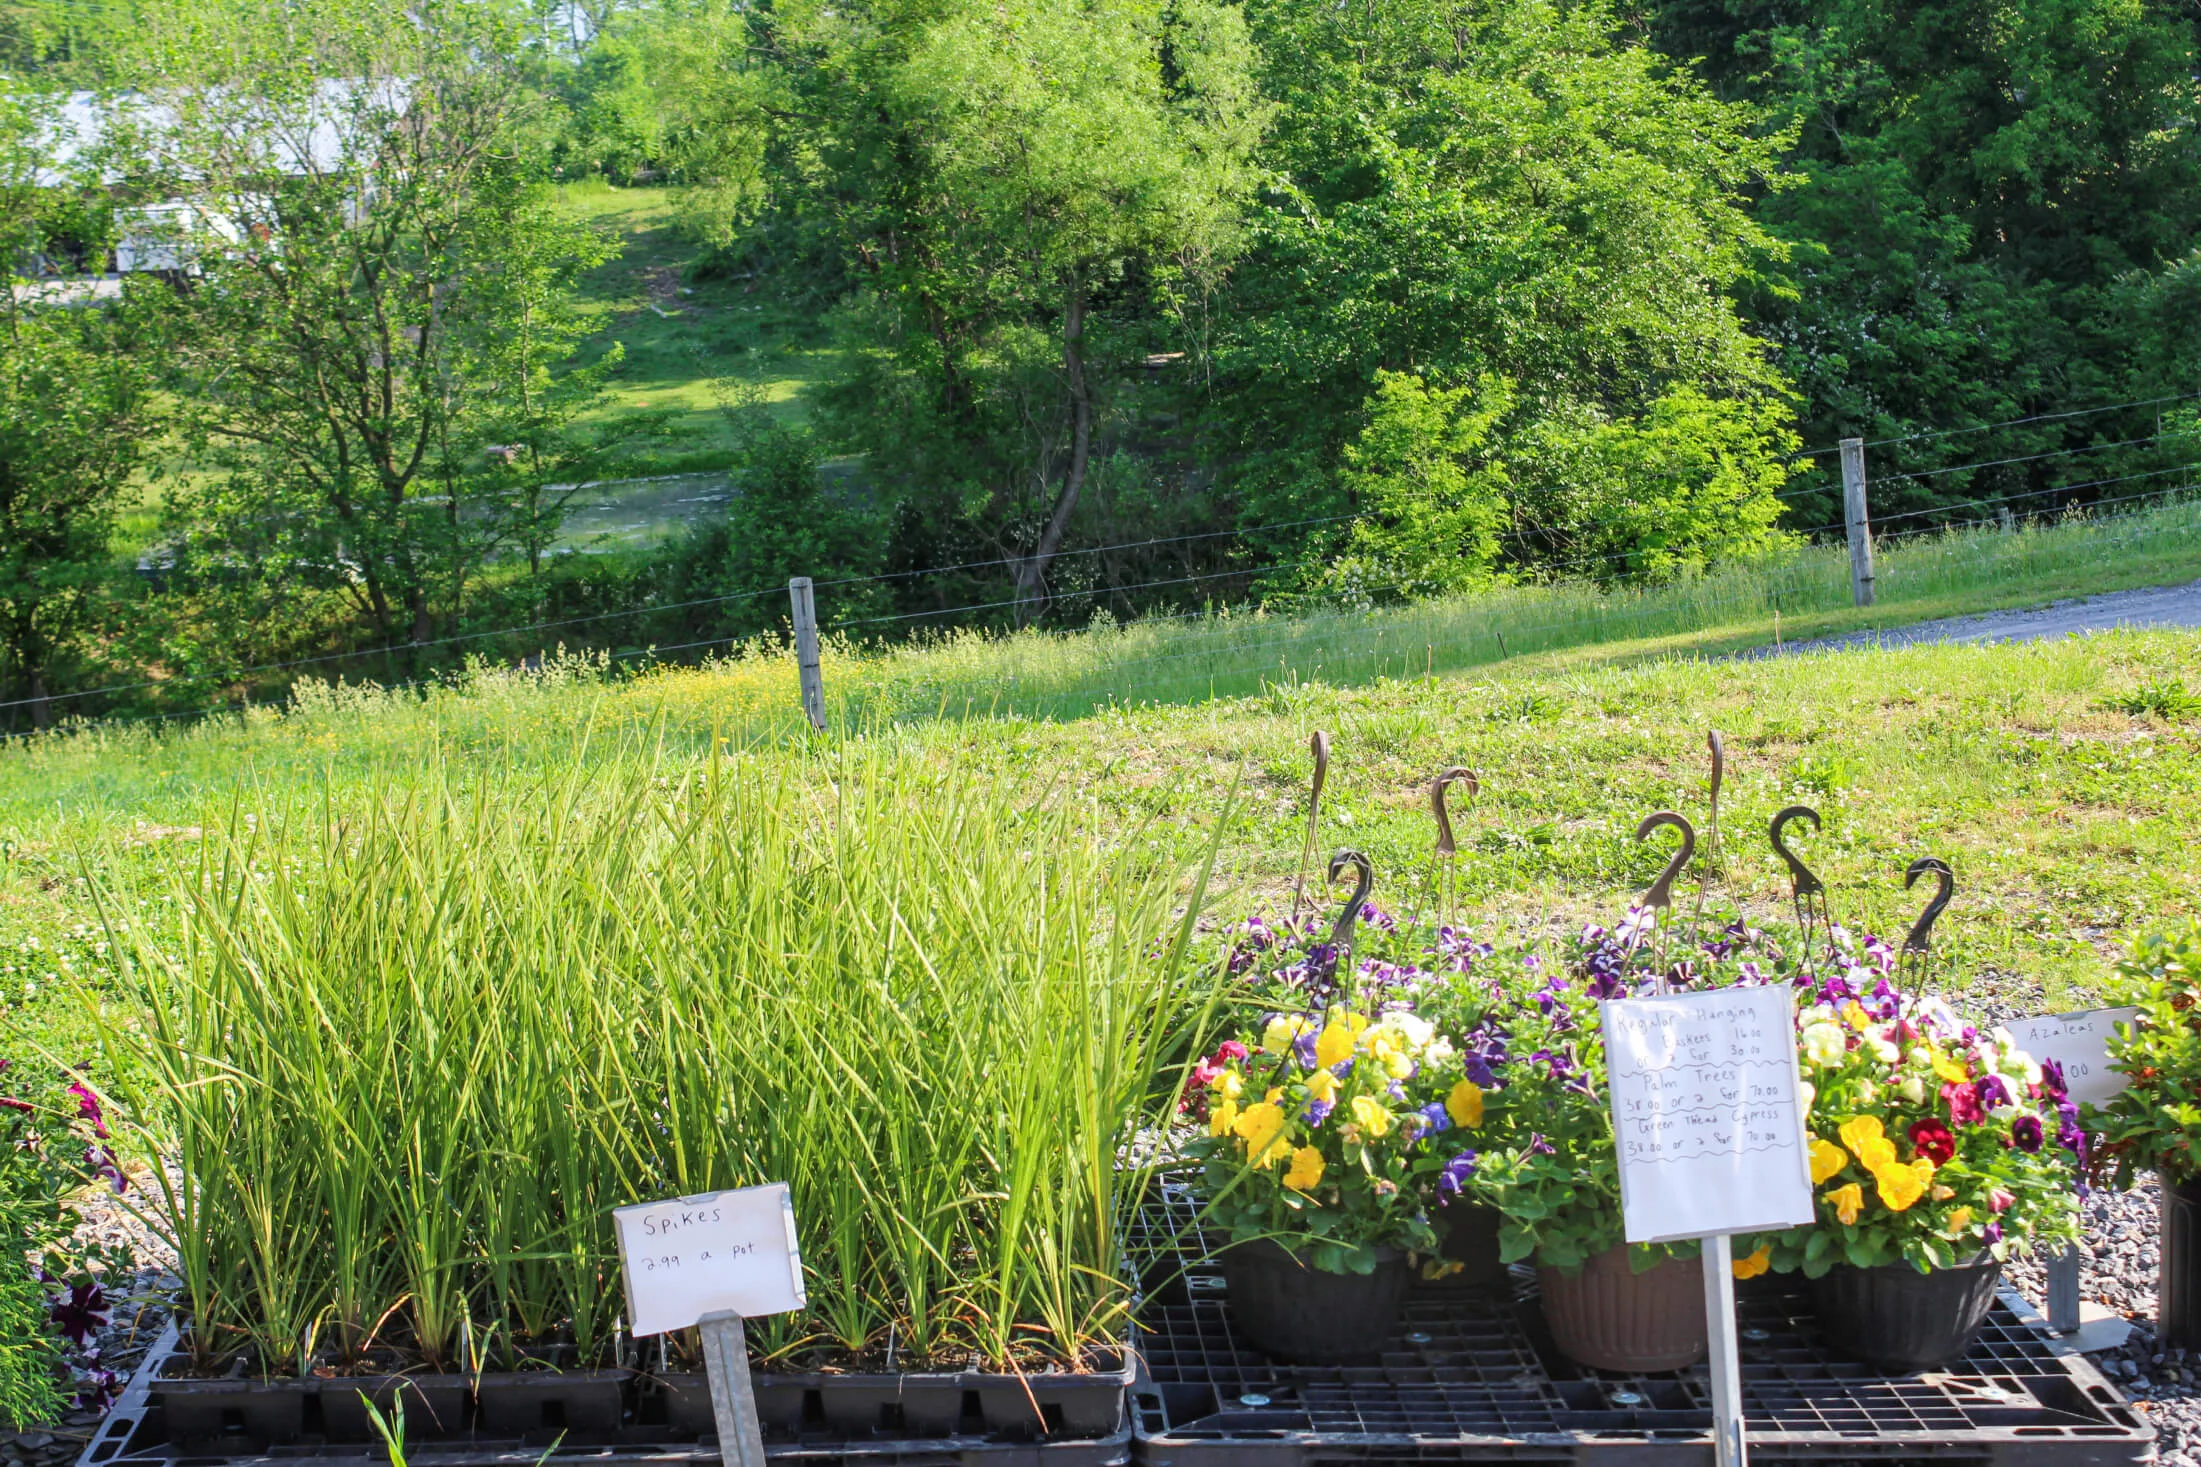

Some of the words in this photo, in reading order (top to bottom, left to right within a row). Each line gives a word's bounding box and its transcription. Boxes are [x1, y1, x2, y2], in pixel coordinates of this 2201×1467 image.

[1617, 1012, 1675, 1034] Regular
[1695, 1006, 1756, 1022] Hanging
[2029, 1022, 2094, 1041] Azaleas
[1637, 1056, 1649, 1069] or
[1689, 1047, 1711, 1061] for
[1643, 1072, 1678, 1091] Palm
[1695, 1069, 1736, 1083] Trees
[2064, 1062, 2089, 1078] .00
[1671, 1096, 1685, 1108] or
[1694, 1094, 1704, 1103] 2
[1720, 1087, 1740, 1100] for
[1749, 1084, 1778, 1096] 70.00
[1638, 1119, 1674, 1134] Green
[1731, 1109, 1779, 1126] Cypress
[1672, 1139, 1685, 1150] or
[1713, 1132, 1732, 1144] for
[643, 1208, 721, 1236] Spikes
[641, 1255, 681, 1271] 2.99
[701, 1250, 713, 1260] a
[732, 1241, 755, 1259] pot
